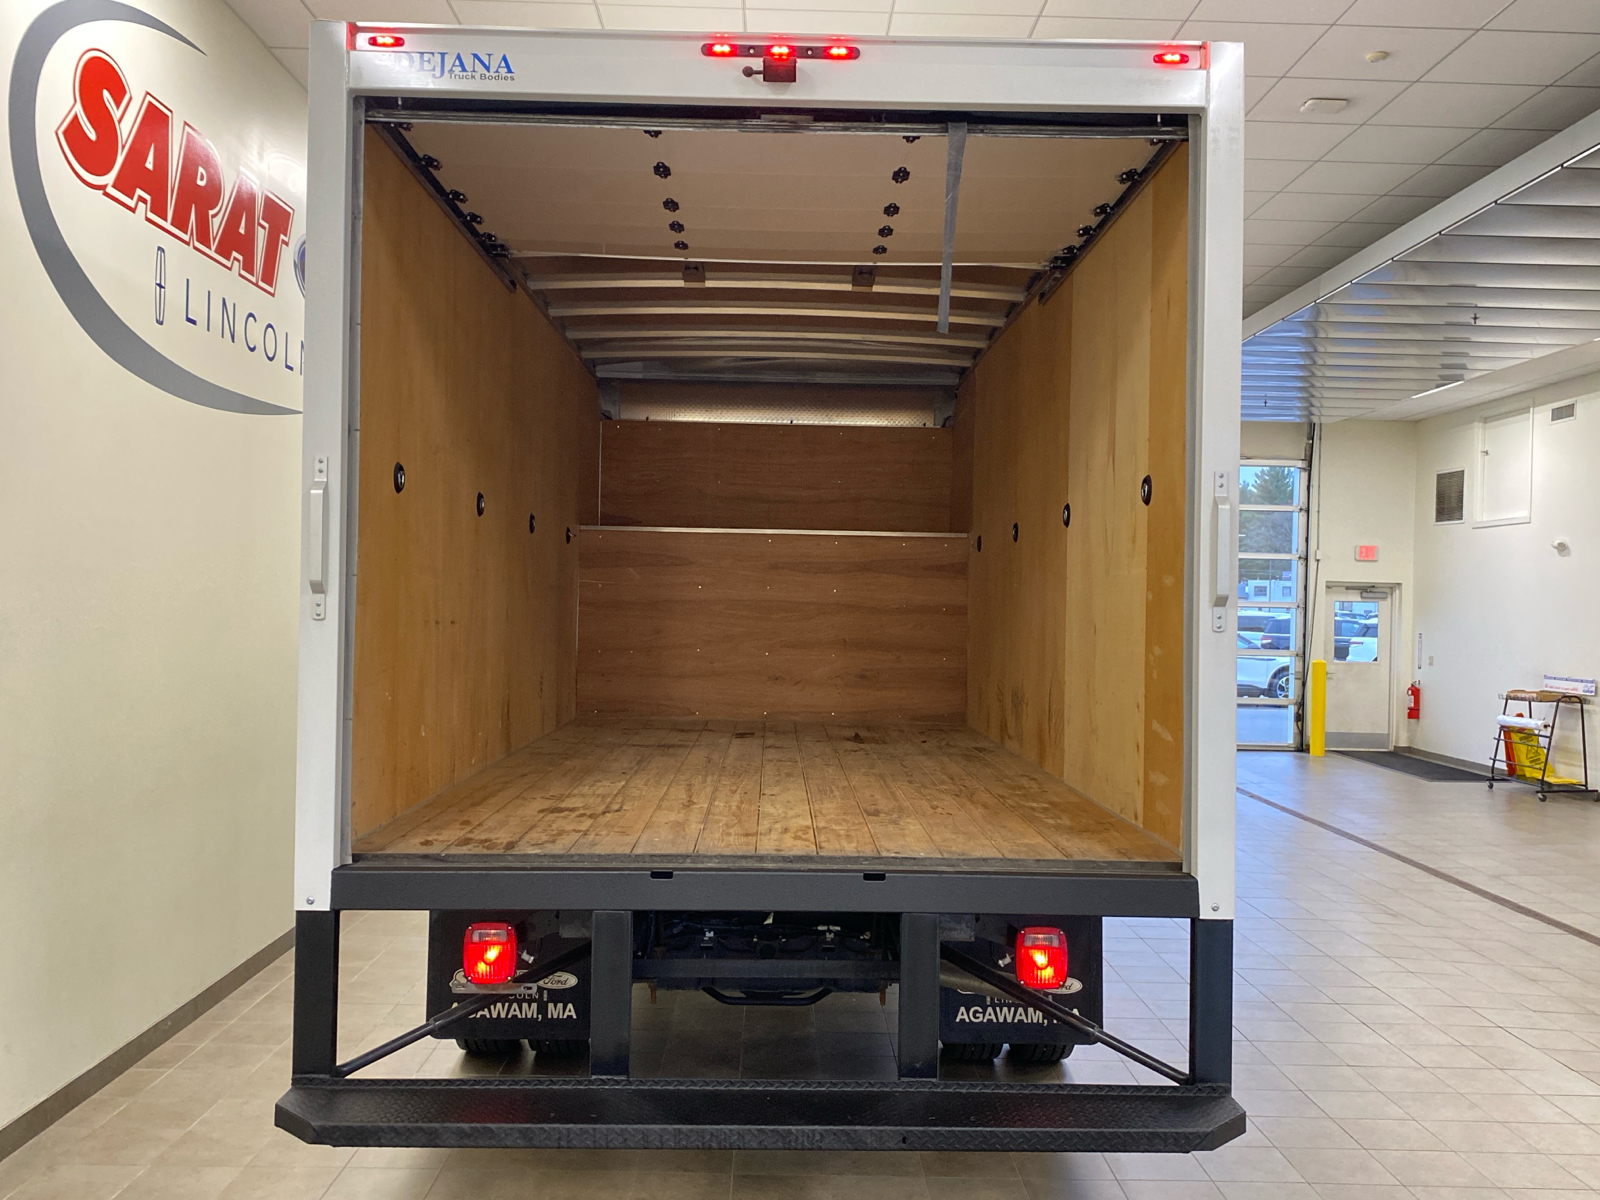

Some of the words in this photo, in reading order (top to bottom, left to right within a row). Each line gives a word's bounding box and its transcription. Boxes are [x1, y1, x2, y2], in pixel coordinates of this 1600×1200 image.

[393, 51, 515, 79] DEJANA
[449, 72, 477, 80] Truck
[479, 73, 515, 81] Bodies
[56, 48, 295, 298] SARAT
[543, 974, 569, 986] Ford
[451, 1002, 542, 1022] AWAM,
[547, 1002, 577, 1019] MA
[955, 1006, 1048, 1027] AGAWAM,
